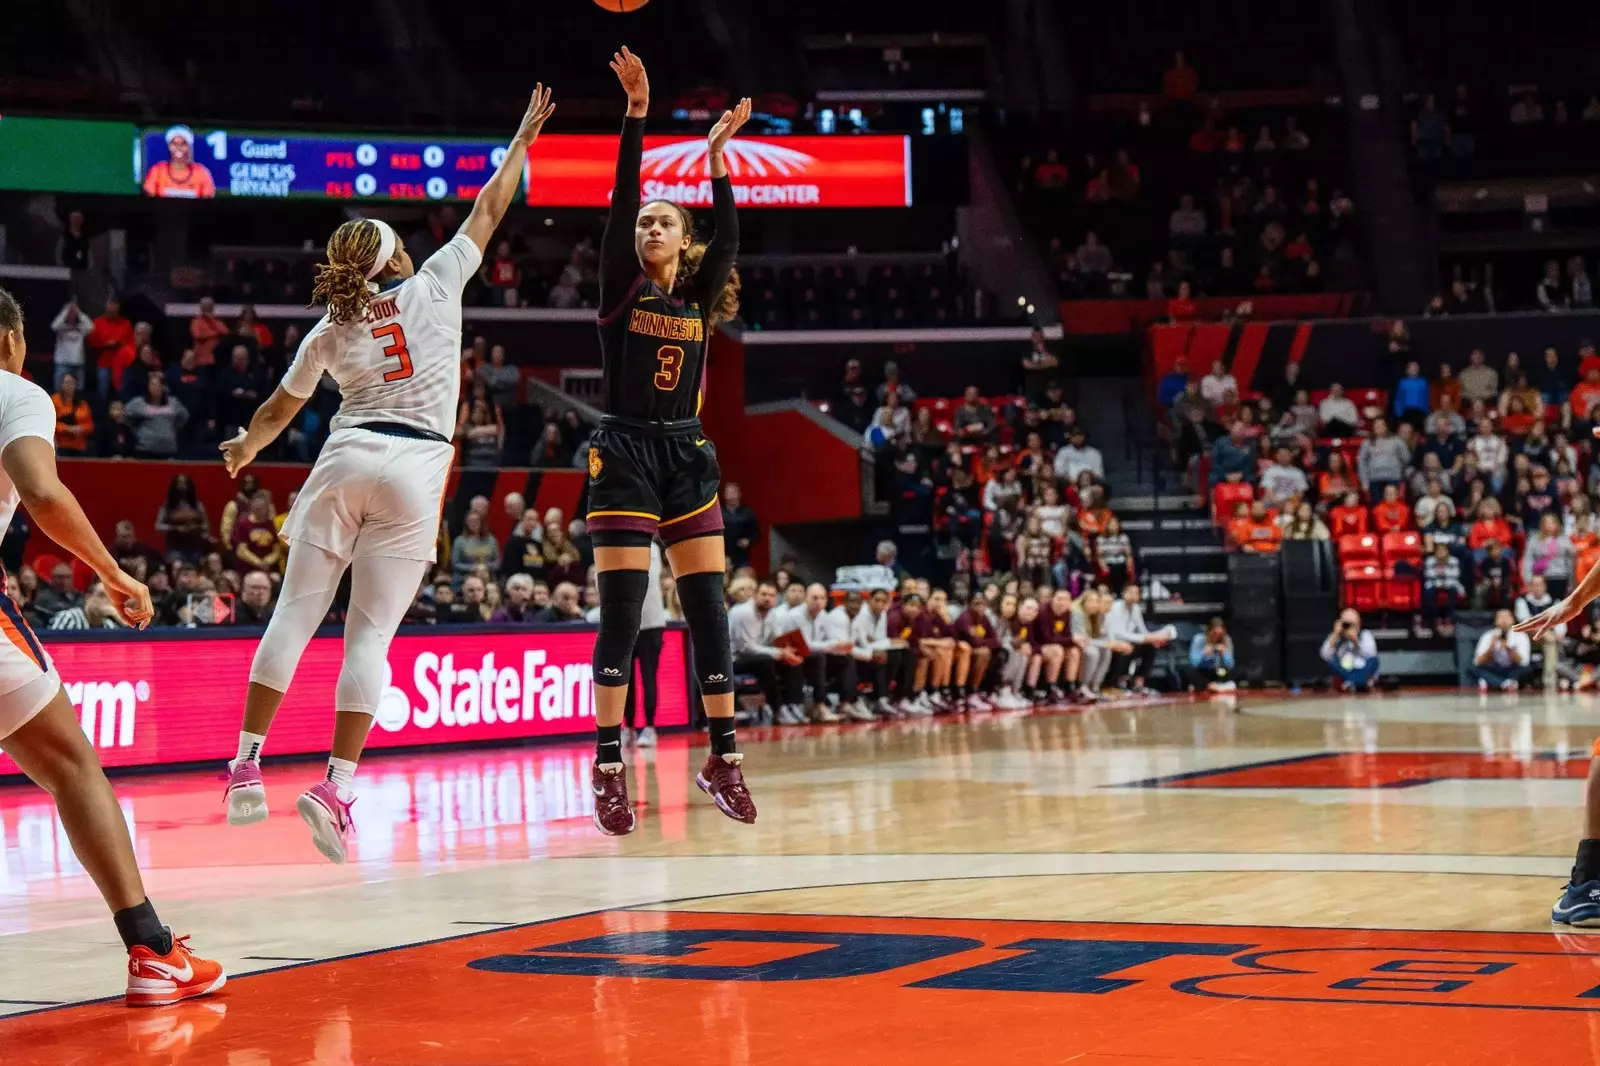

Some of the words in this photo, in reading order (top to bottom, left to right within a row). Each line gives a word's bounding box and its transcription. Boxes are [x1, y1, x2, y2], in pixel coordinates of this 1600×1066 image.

[206, 131, 228, 160] 1
[240, 139, 287, 159] Guard
[356, 143, 378, 167] 0
[423, 145, 445, 168] 0
[229, 162, 296, 182] GENESIS
[355, 173, 377, 197] 0
[426, 176, 448, 200] 0
[750, 185, 820, 204] CENTER
[628, 308, 704, 342] MINNESOT
[371, 322, 414, 383] 3
[654, 345, 685, 391] 3
